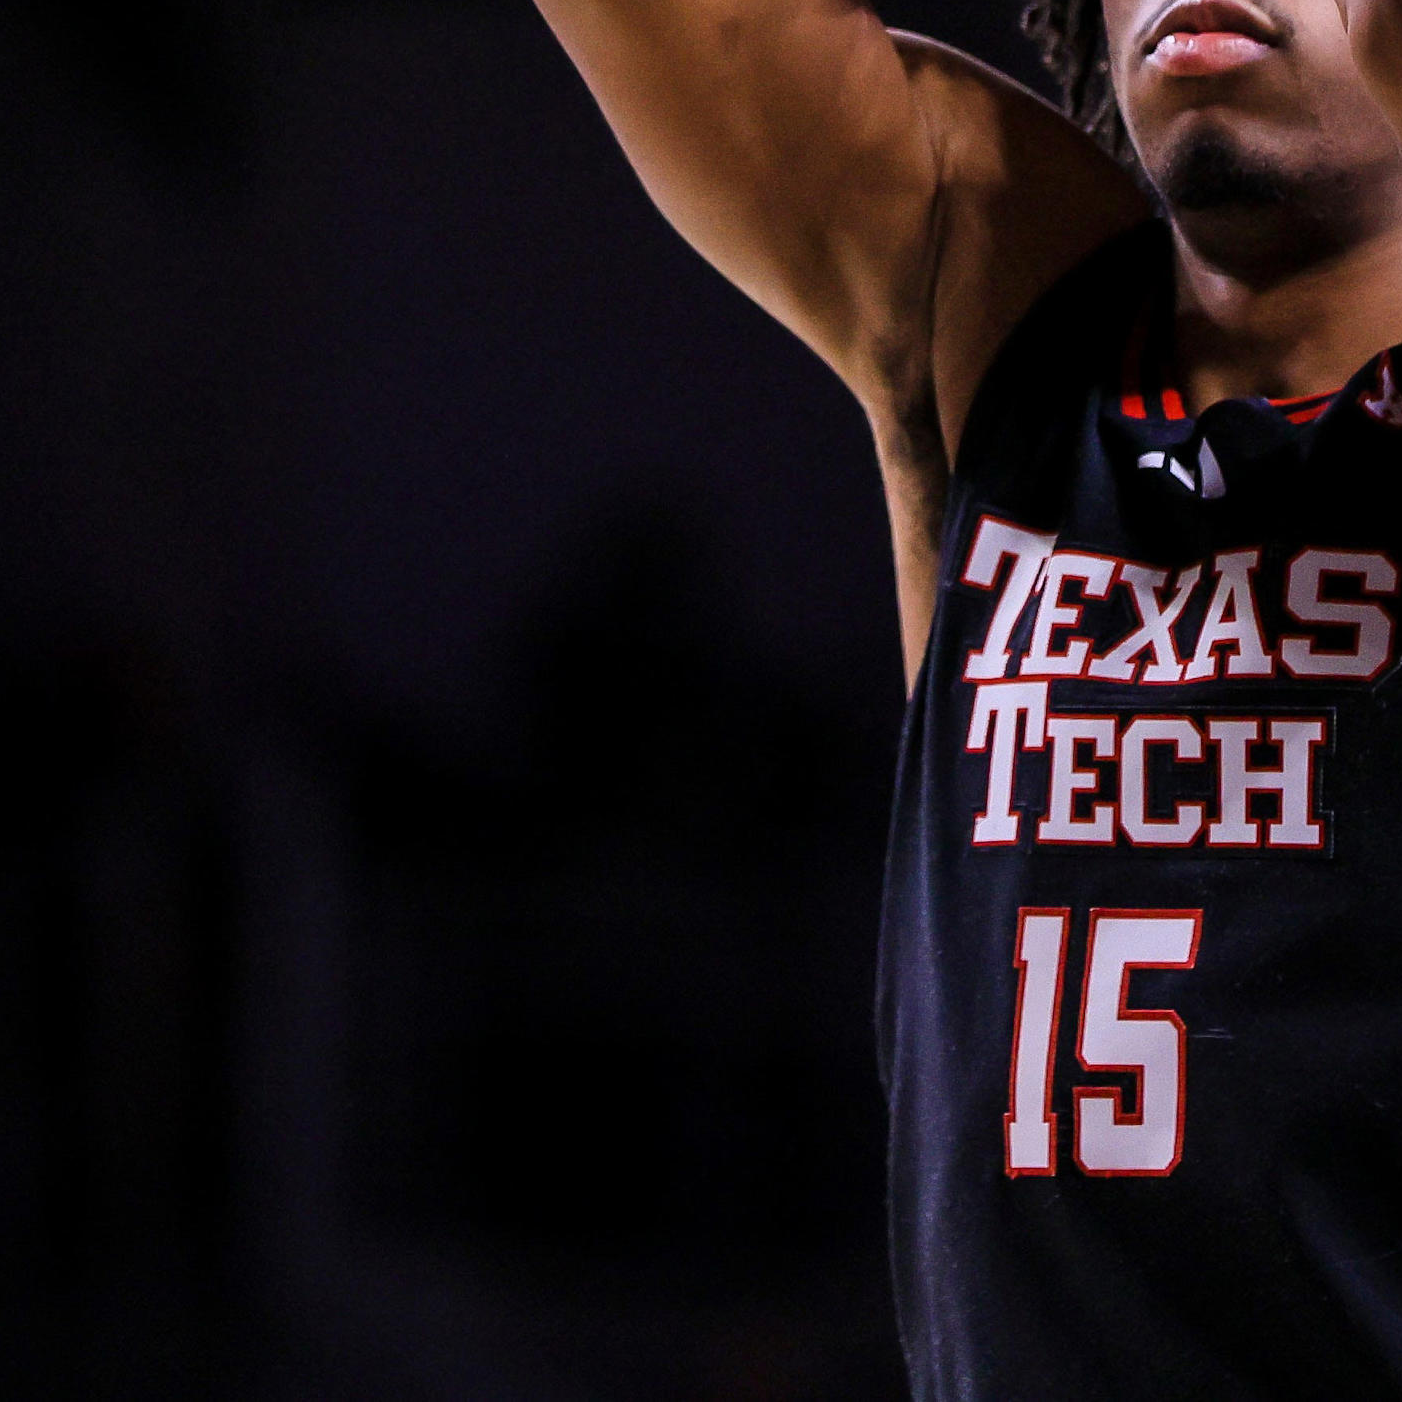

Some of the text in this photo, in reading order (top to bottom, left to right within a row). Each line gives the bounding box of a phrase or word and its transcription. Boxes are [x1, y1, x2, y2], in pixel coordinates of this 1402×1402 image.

[962, 514, 1399, 684] TEXAS
[965, 680, 1326, 847] TECH
[1004, 907, 1203, 1178] 15
